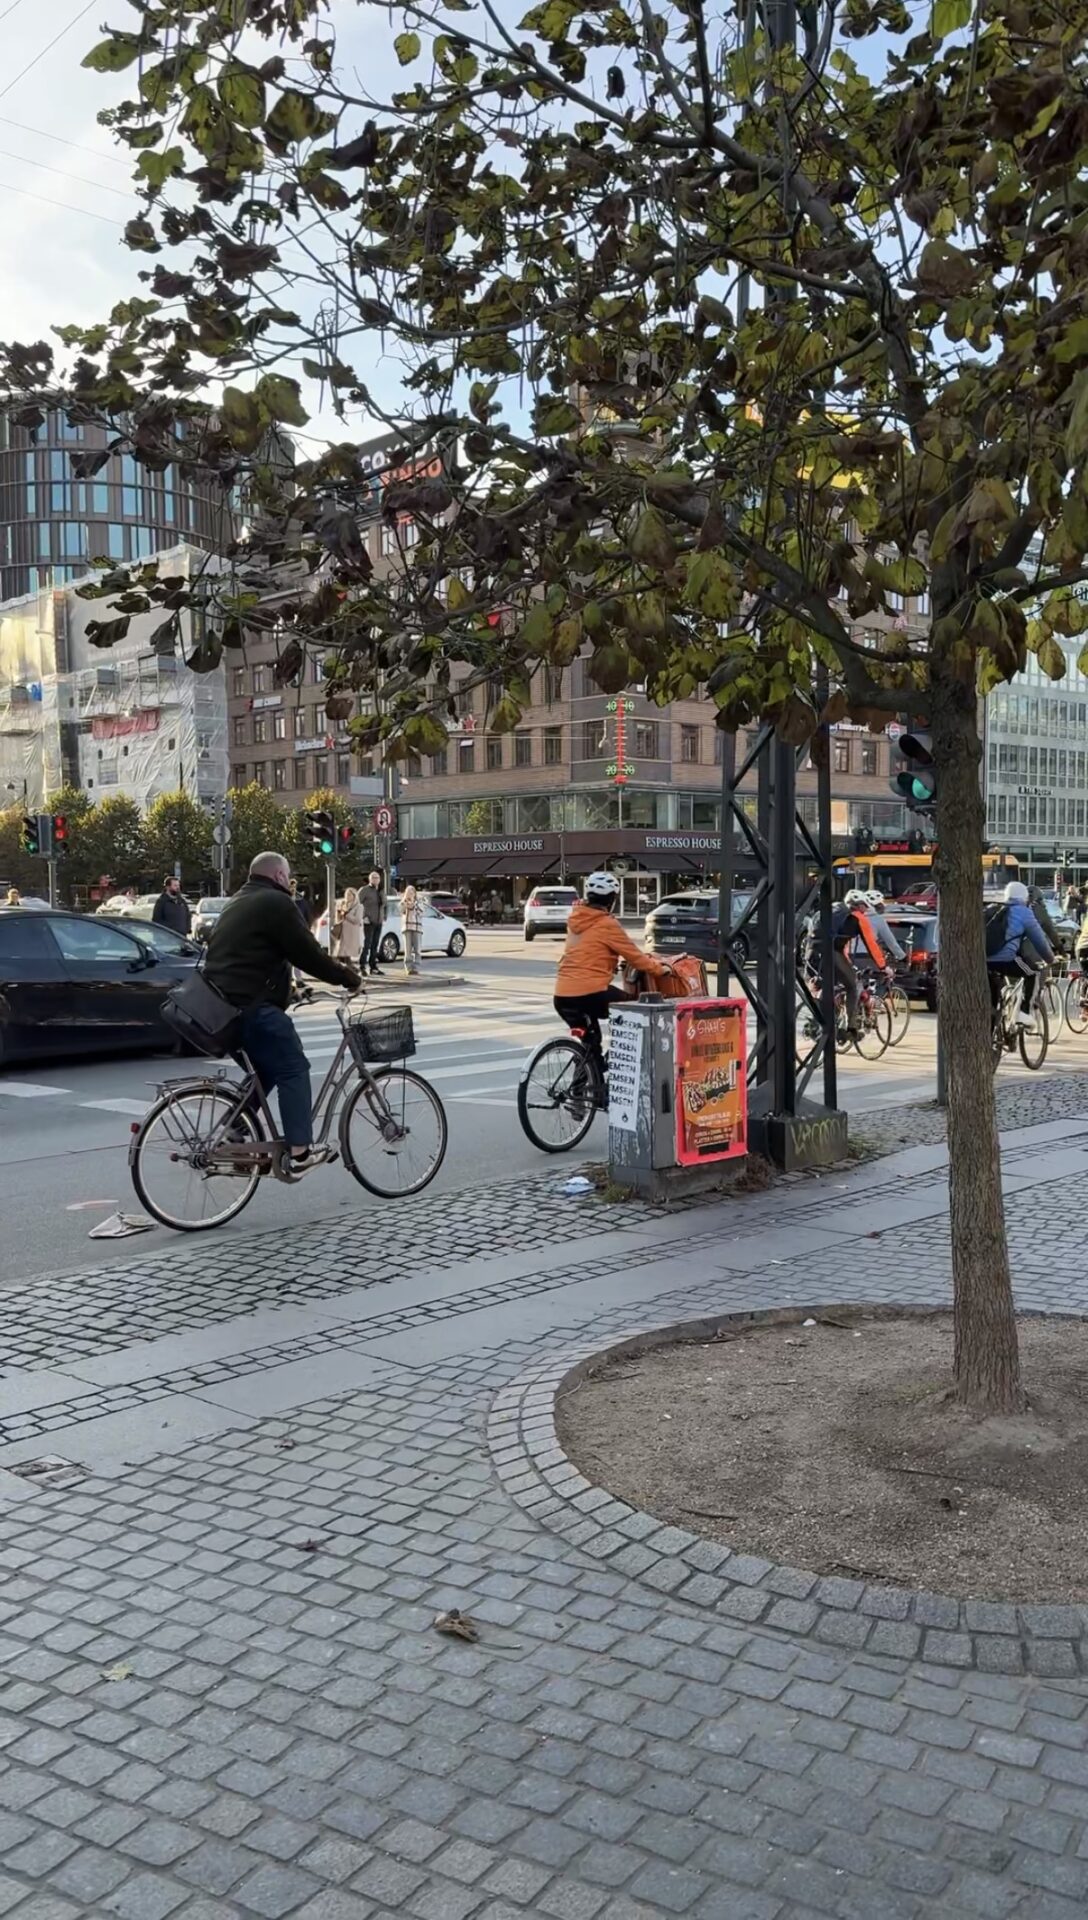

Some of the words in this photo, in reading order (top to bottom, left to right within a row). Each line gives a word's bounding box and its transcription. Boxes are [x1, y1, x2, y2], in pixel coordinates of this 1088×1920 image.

[474, 841, 513, 854] ESPRESSO
[514, 840, 544, 851] HOUSE
[645, 836, 690, 849] ESPRESSO
[691, 837, 721, 850] HOUSE
